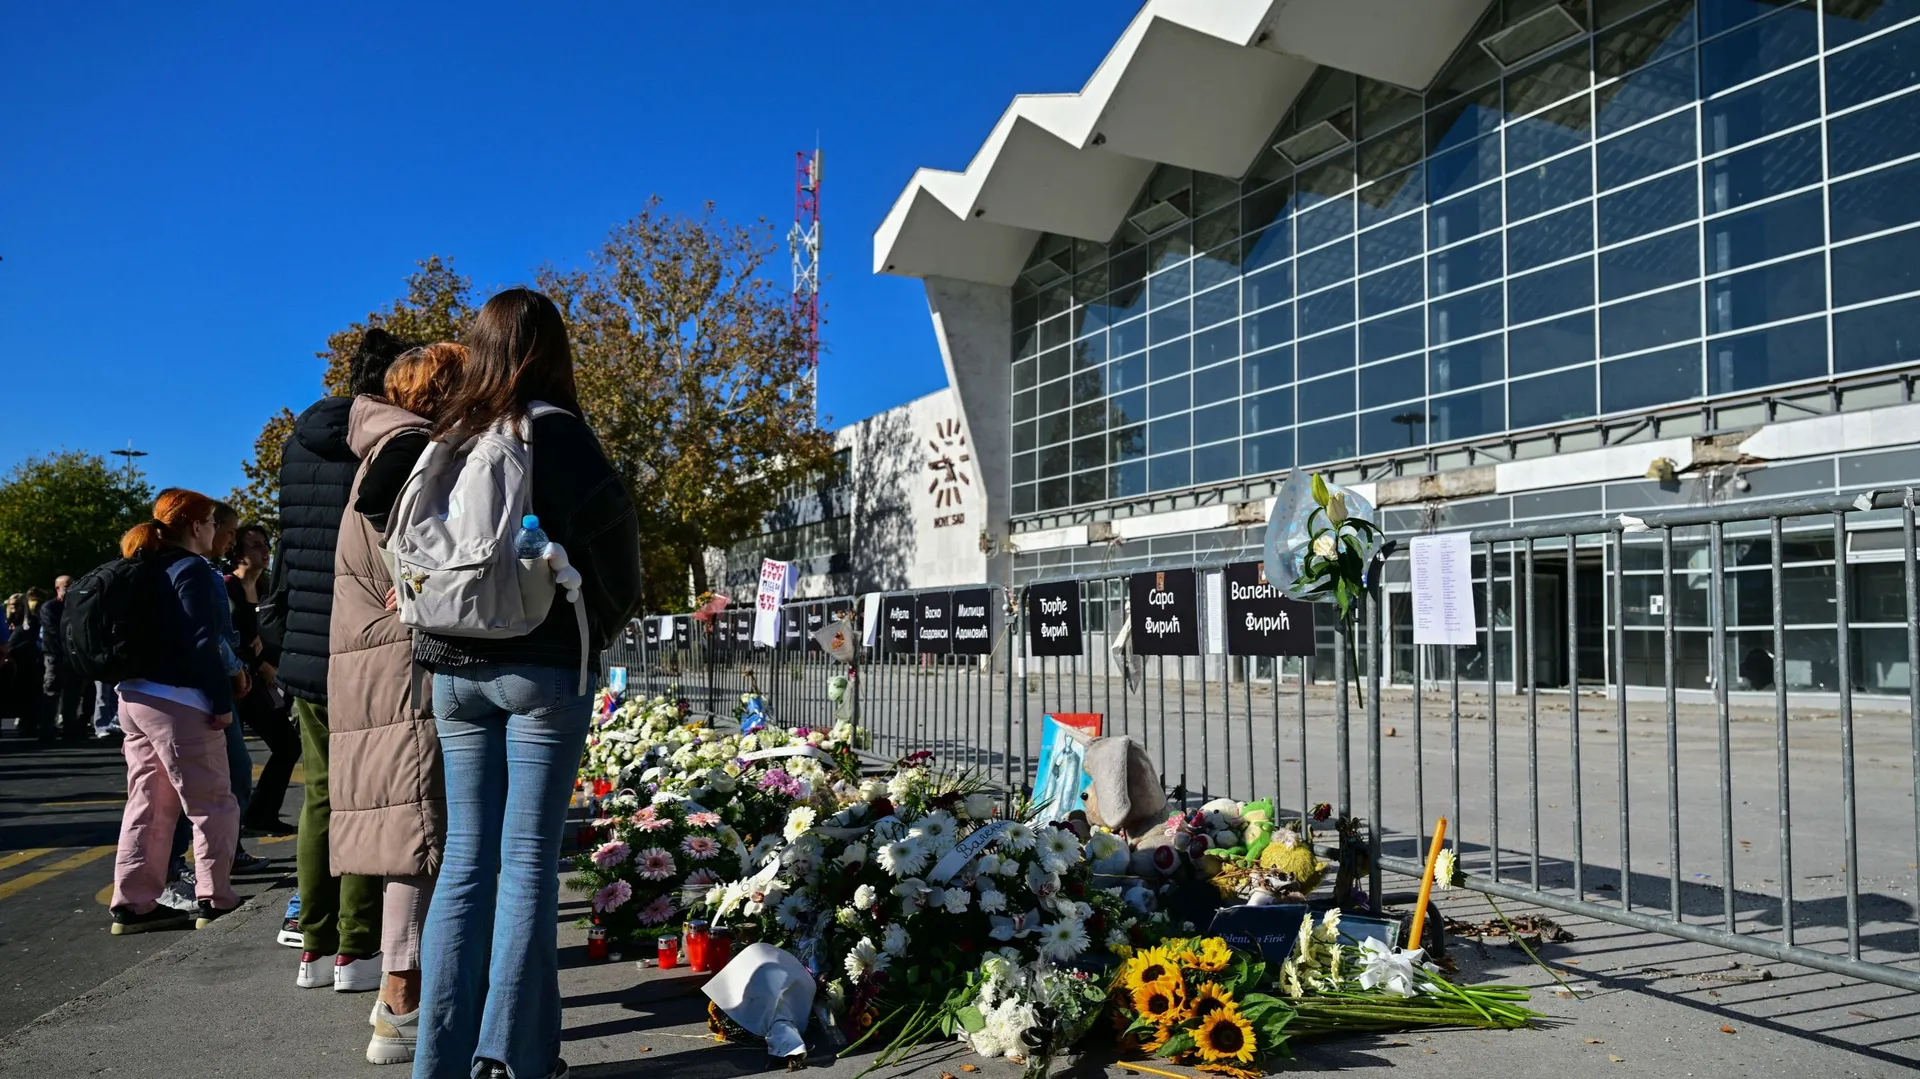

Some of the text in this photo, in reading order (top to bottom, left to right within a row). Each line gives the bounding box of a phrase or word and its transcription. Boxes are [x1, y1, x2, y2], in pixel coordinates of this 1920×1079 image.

[952, 513, 964, 525] SAD
[1040, 596, 1068, 616] Ђорђе
[1149, 588, 1174, 610] Сара
[890, 607, 910, 621] Анђела
[925, 606, 942, 619] Васко
[958, 604, 985, 618] Милица
[1145, 615, 1180, 638] Фирић
[1245, 610, 1290, 636] Фирић
[891, 626, 908, 641] Руман
[955, 624, 988, 640] Адамовић
[1041, 621, 1069, 641] Фирић
[1264, 933, 1286, 944] Firić
